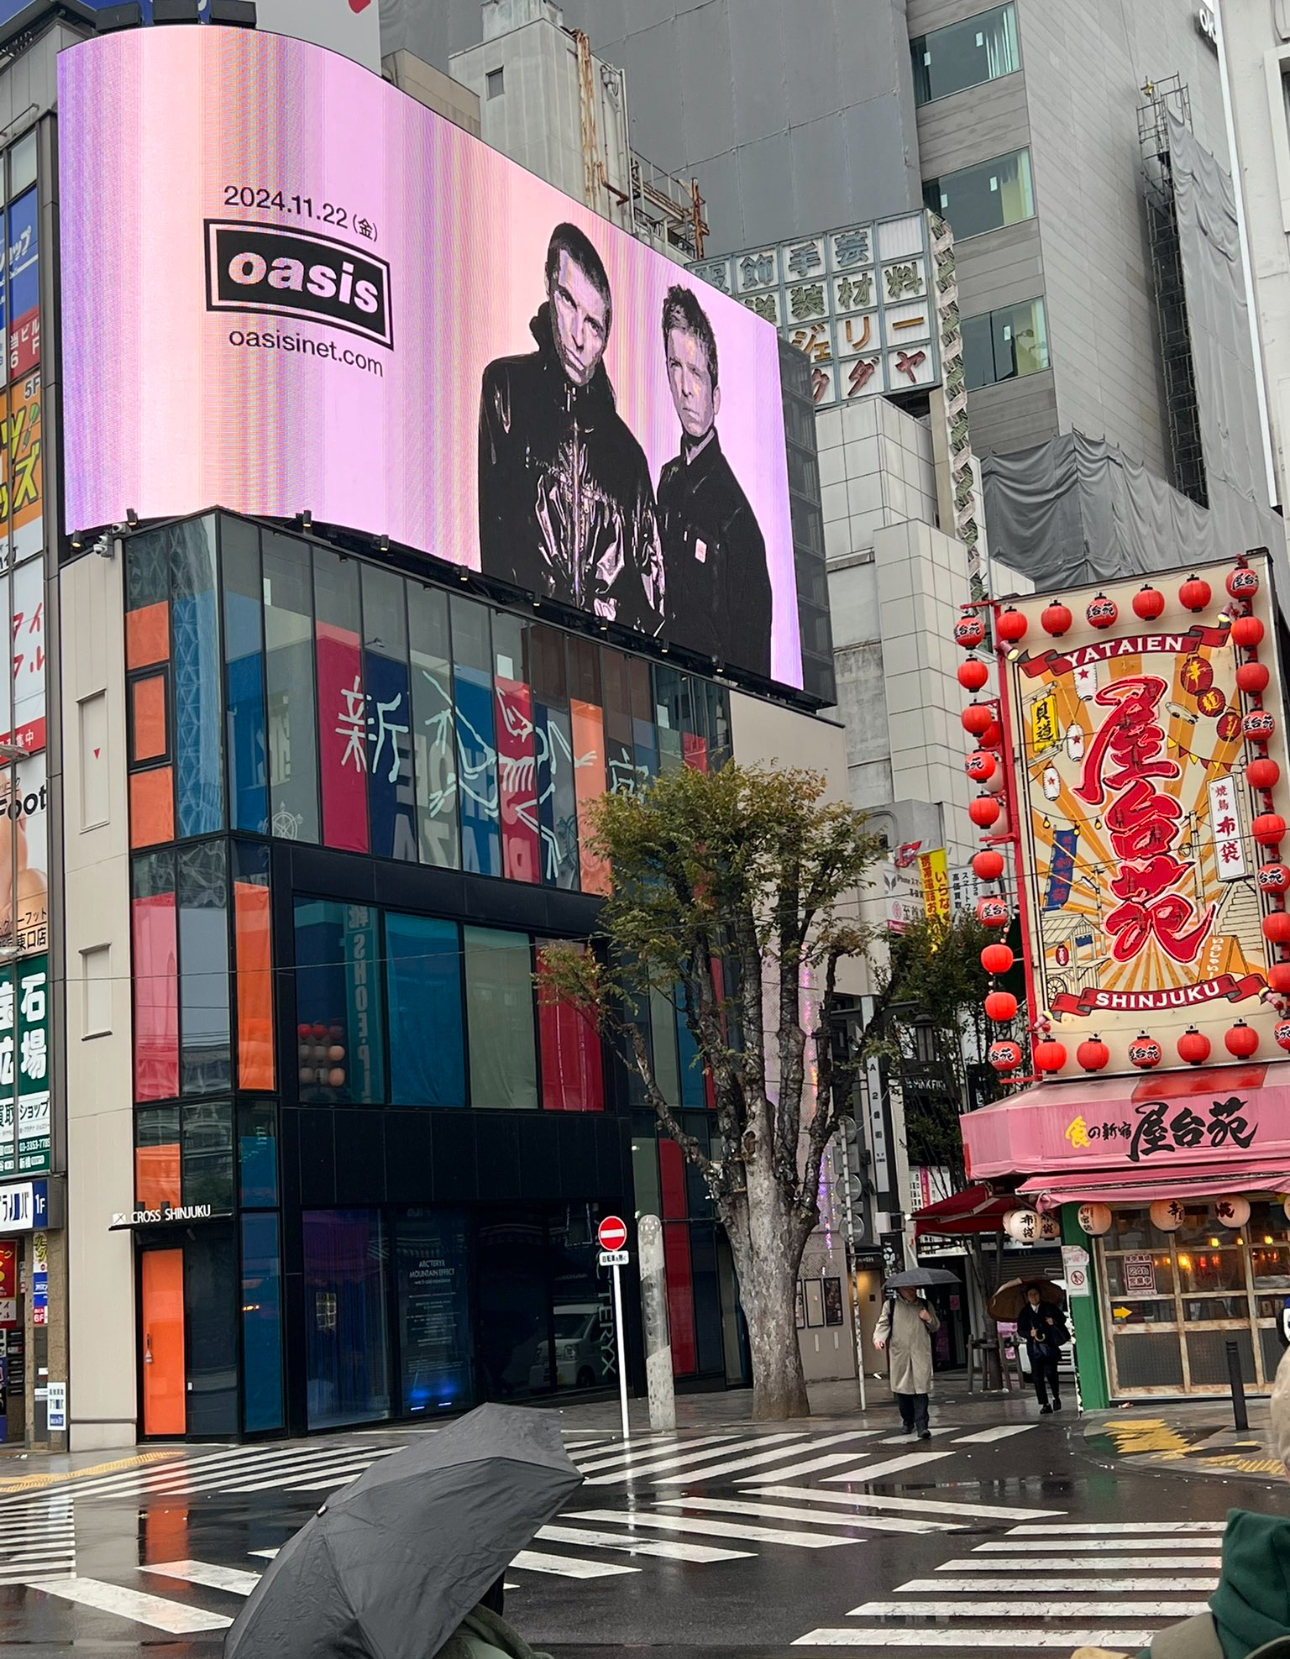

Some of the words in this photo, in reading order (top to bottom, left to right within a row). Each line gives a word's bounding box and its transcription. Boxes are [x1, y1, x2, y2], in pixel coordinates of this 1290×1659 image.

[228, 250, 379, 314] oasis
[229, 329, 384, 377] oasisinet.com
[24, 377, 41, 399] 5F
[1232, 573, 1258, 590] 屋台
[1064, 636, 1183, 668] YATAIEN
[1095, 981, 1221, 1008] SHINJUKU
[1125, 1097, 1259, 1162] 屋台苑
[35, 1194, 45, 1214] 1F
[131, 1209, 161, 1225] CROSS
[165, 1204, 211, 1221] SHINJUKU
